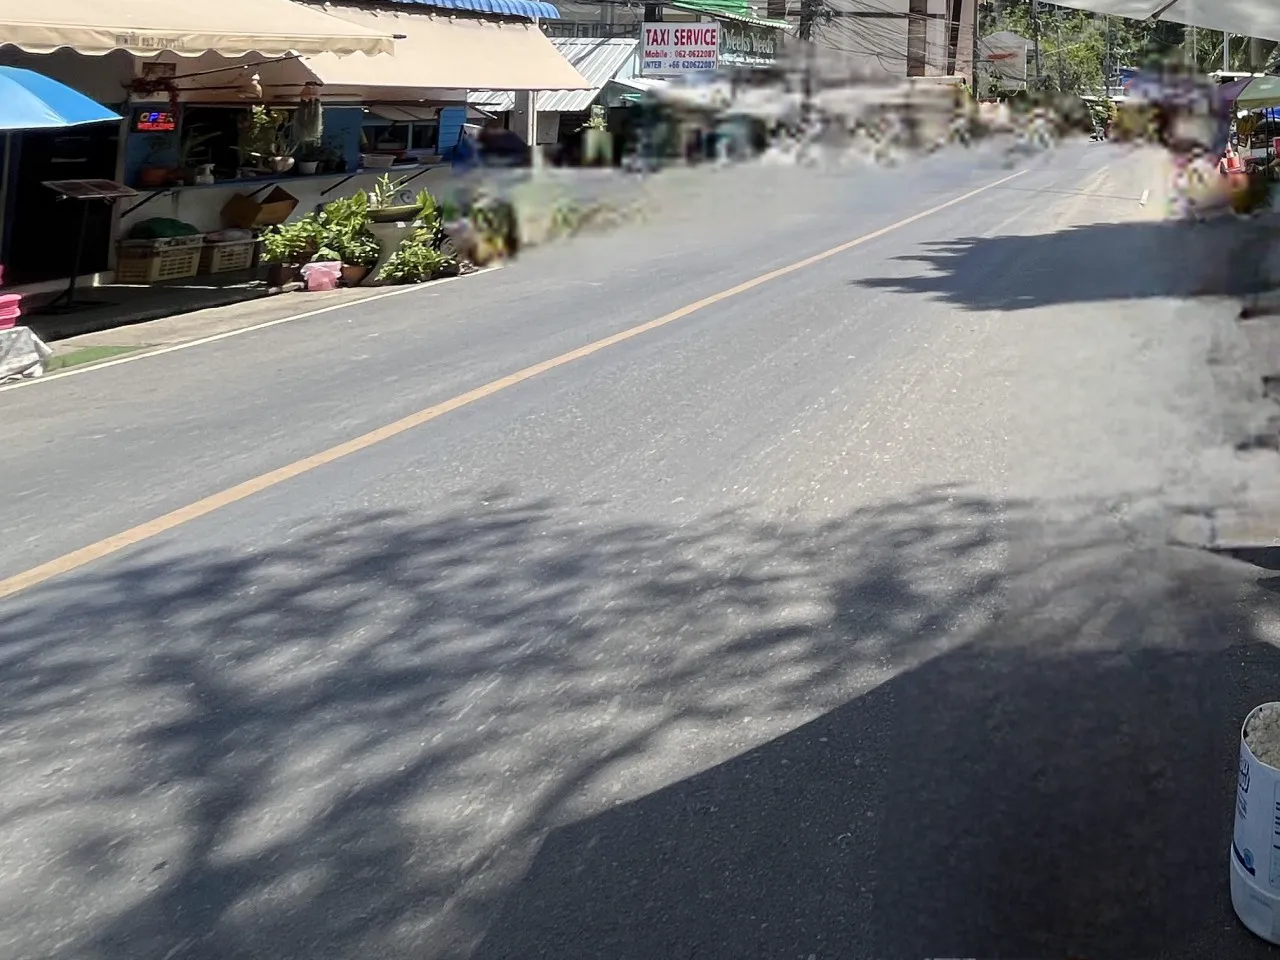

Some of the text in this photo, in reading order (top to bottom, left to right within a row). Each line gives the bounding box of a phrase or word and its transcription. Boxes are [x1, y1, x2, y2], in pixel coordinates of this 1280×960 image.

[645, 28, 717, 47] TAXI SERVICE
[644, 50, 667, 58] Mobile
[675, 50, 715, 58] 062-0622087
[643, 60, 662, 69] INTER
[668, 61, 680, 69] +66
[682, 60, 715, 69] 620622087
